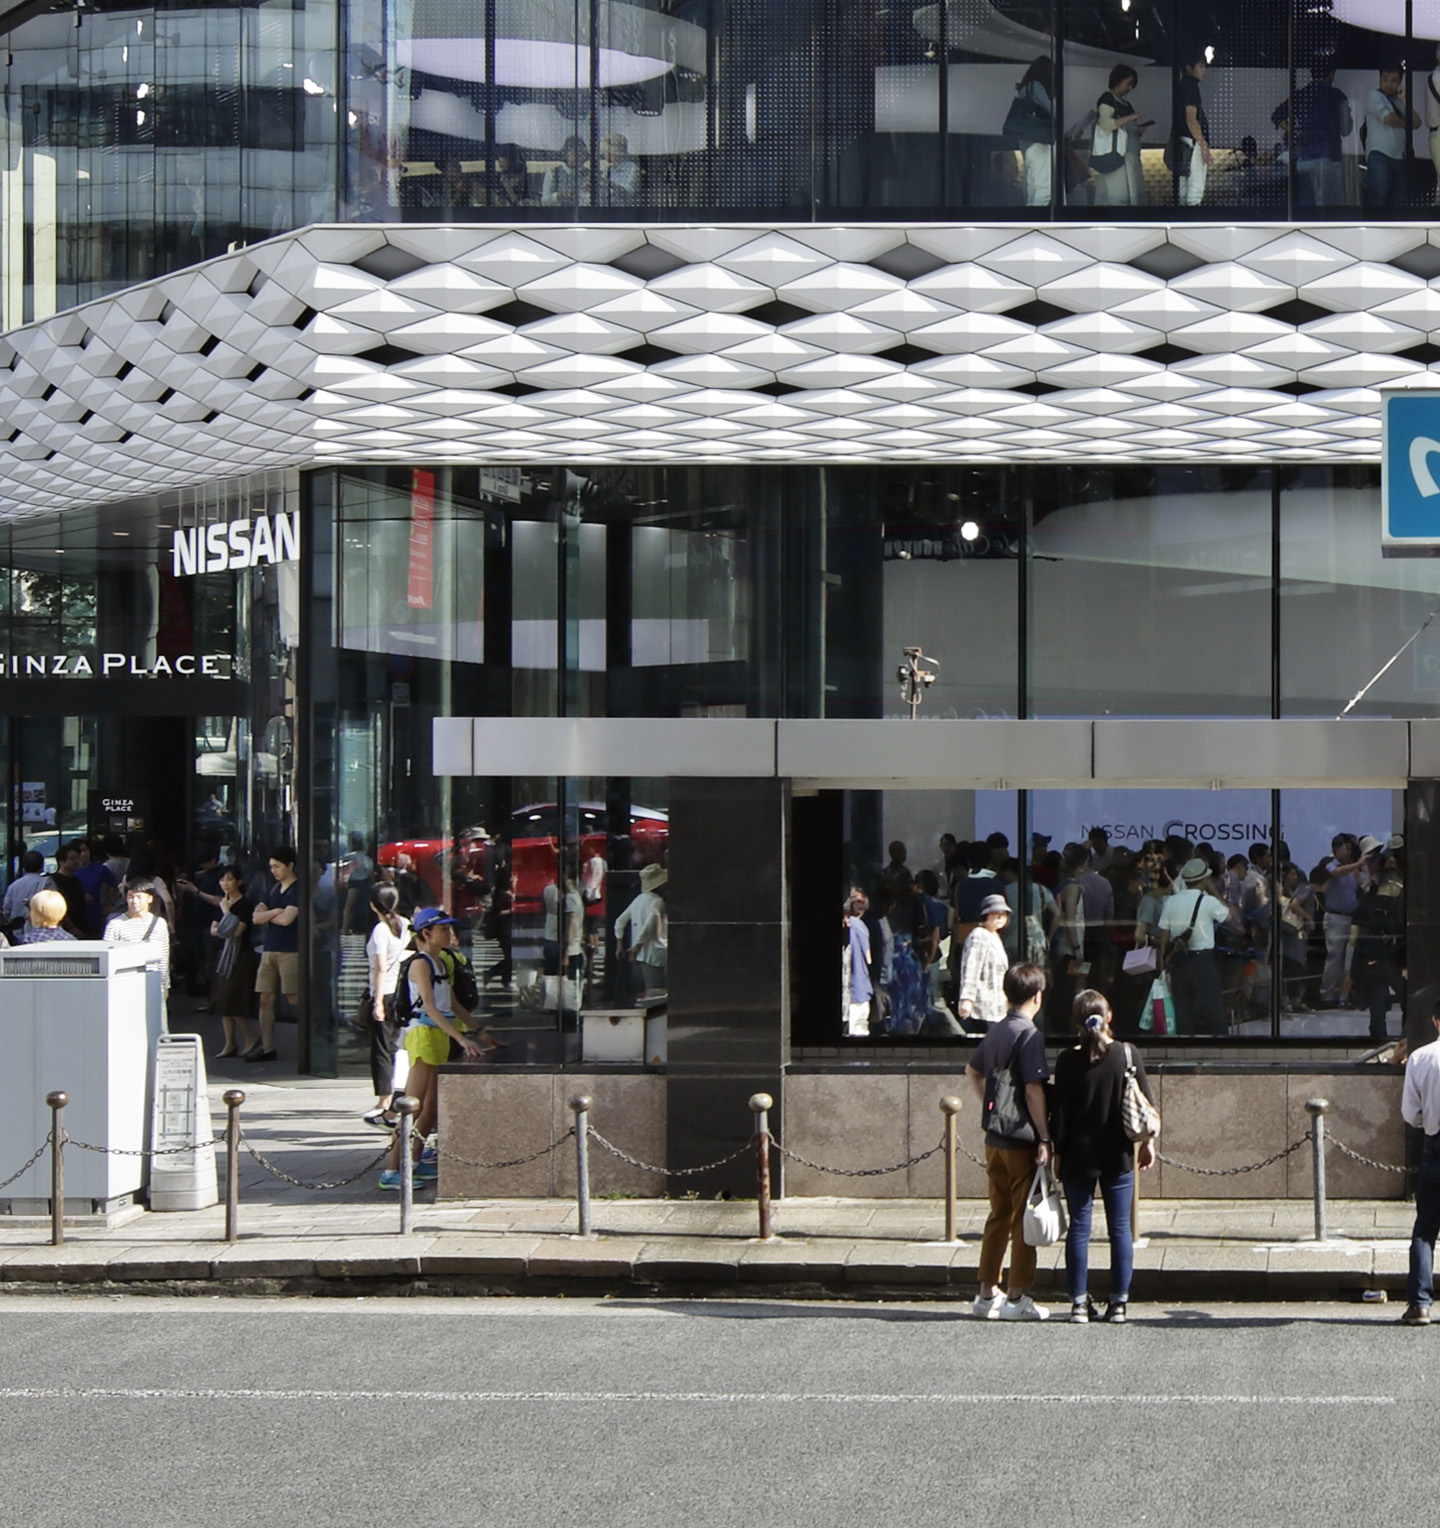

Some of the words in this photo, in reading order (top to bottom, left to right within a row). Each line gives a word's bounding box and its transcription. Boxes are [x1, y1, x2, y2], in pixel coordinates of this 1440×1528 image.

[173, 510, 301, 577] NISSAN
[101, 652, 222, 676] PLACE
[102, 798, 134, 806] GINZA
[1080, 824, 1154, 840] NSSAN
